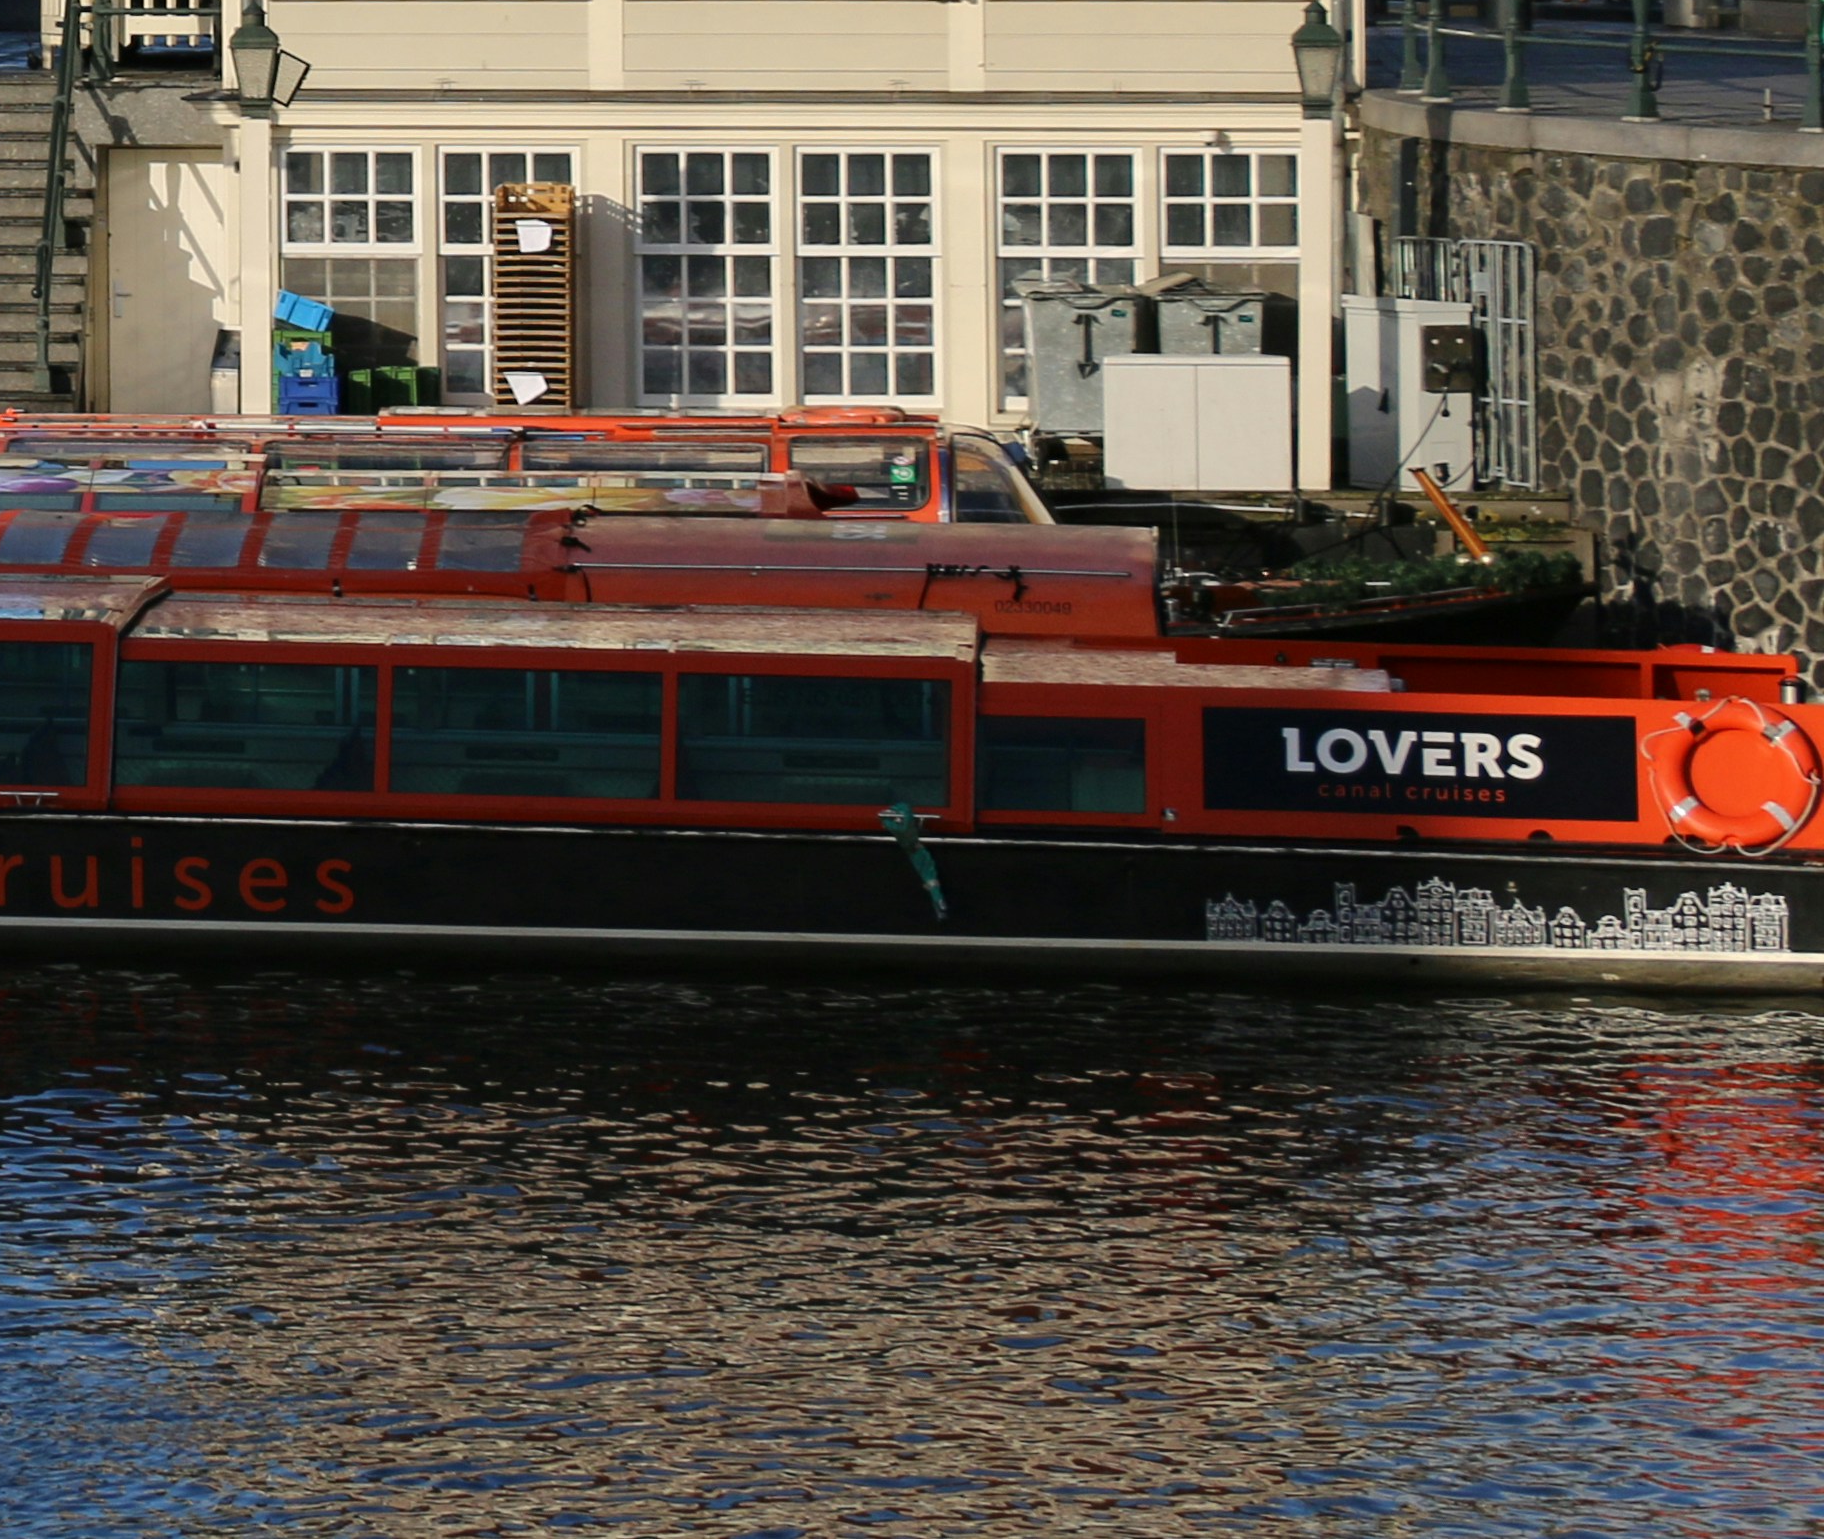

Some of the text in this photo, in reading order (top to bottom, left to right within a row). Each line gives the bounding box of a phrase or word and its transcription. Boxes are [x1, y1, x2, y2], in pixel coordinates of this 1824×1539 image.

[1281, 726, 1545, 781] LOVERS
[1317, 780, 1508, 804] canal cruises
